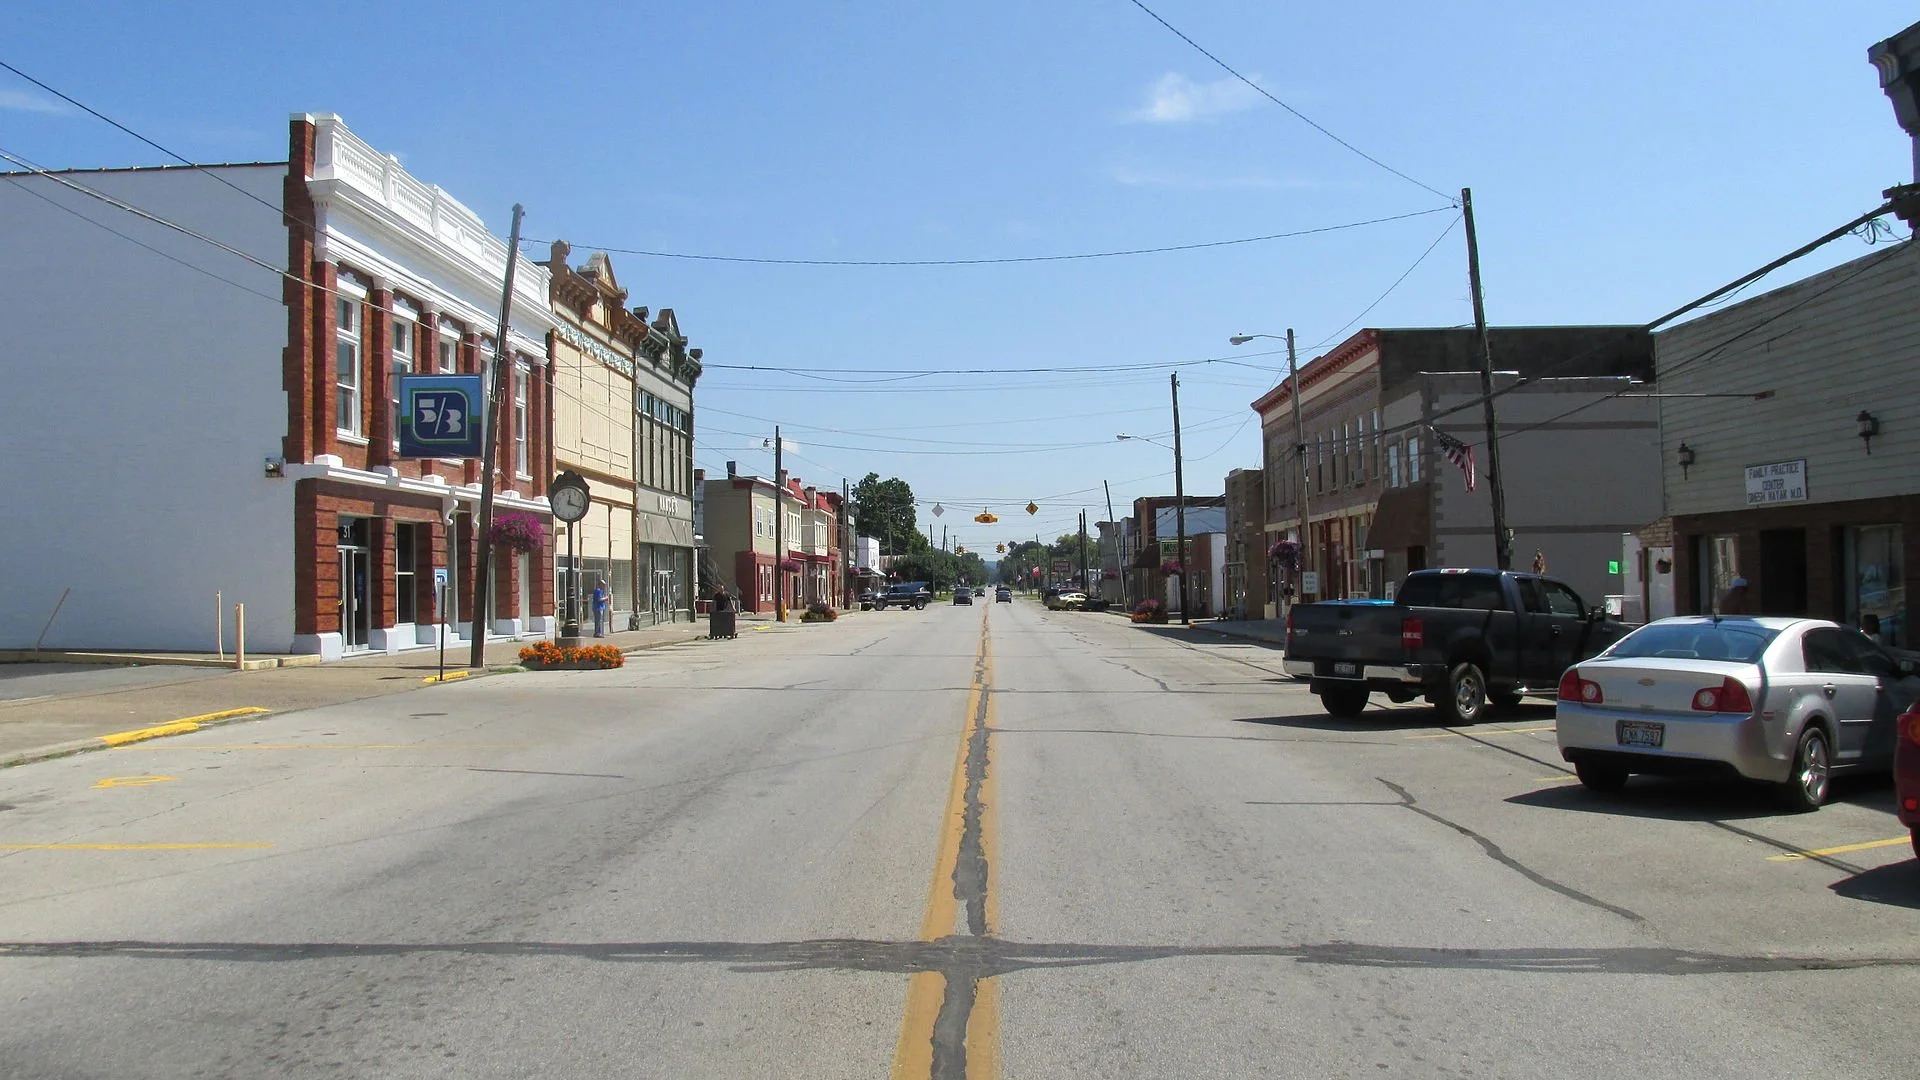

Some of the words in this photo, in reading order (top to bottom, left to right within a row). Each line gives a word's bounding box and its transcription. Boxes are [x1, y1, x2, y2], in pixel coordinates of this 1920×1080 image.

[1749, 467, 1768, 479] FAMILY
[1770, 463, 1799, 475] PRACTICE
[1762, 479, 1784, 490] CENTER
[343, 525, 350, 539] 31
